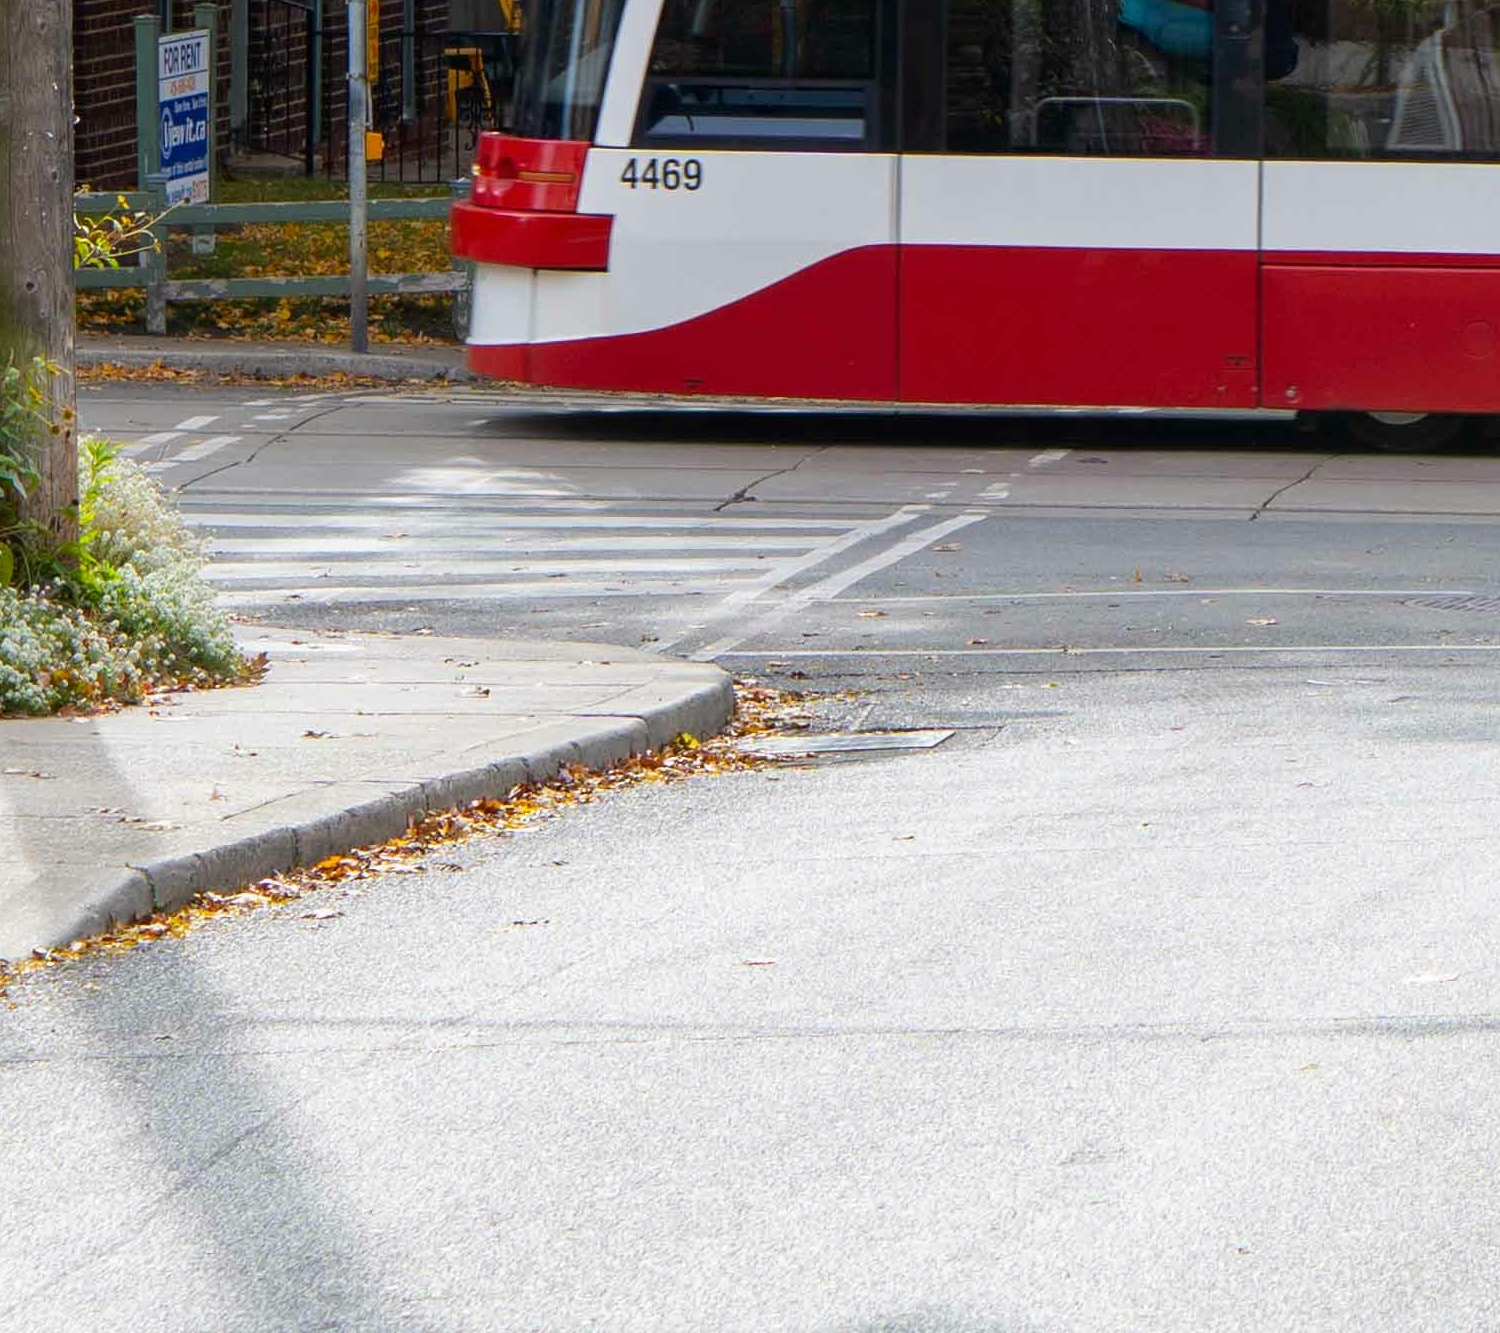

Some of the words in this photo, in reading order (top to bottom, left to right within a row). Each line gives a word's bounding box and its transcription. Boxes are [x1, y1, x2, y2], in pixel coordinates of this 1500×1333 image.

[163, 44, 179, 75] FOR
[180, 41, 201, 71] RENT
[620, 157, 703, 191] 4469
